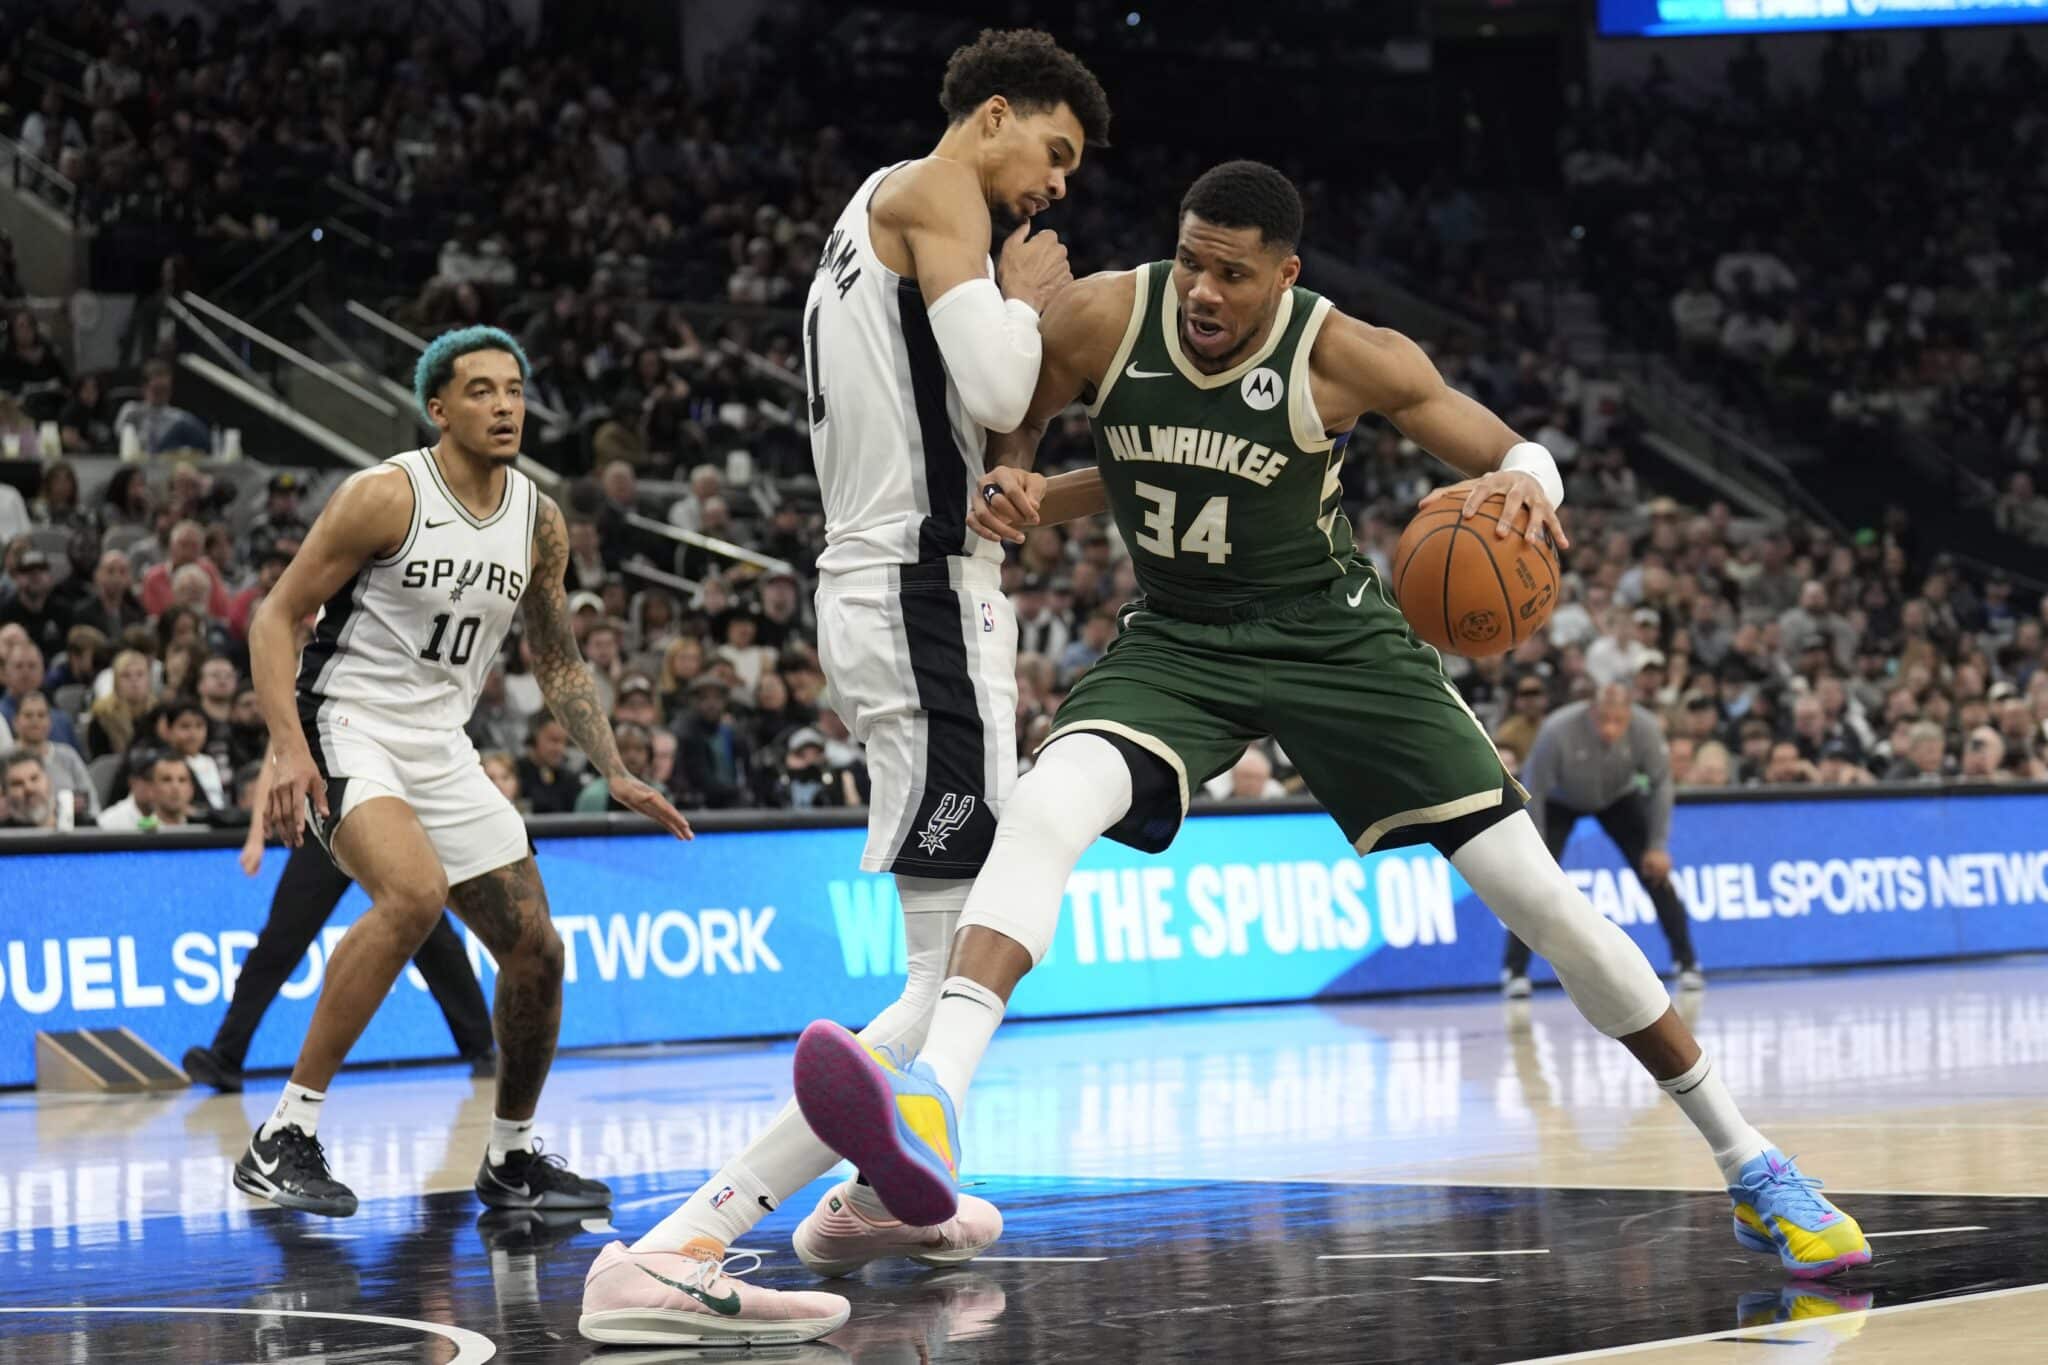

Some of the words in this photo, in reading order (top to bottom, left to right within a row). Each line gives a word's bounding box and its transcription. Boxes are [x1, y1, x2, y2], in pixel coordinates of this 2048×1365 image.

[1103, 424, 1289, 488] MILWAUKEE
[1135, 480, 1232, 565] 34
[401, 558, 524, 603] SPURS
[420, 613, 481, 665] 10
[1064, 866, 1183, 965] THE
[1186, 857, 1372, 959] SPURS
[1375, 855, 1457, 949] ON
[1770, 855, 1926, 918] SPORTS
[0, 935, 166, 1014] UEL
